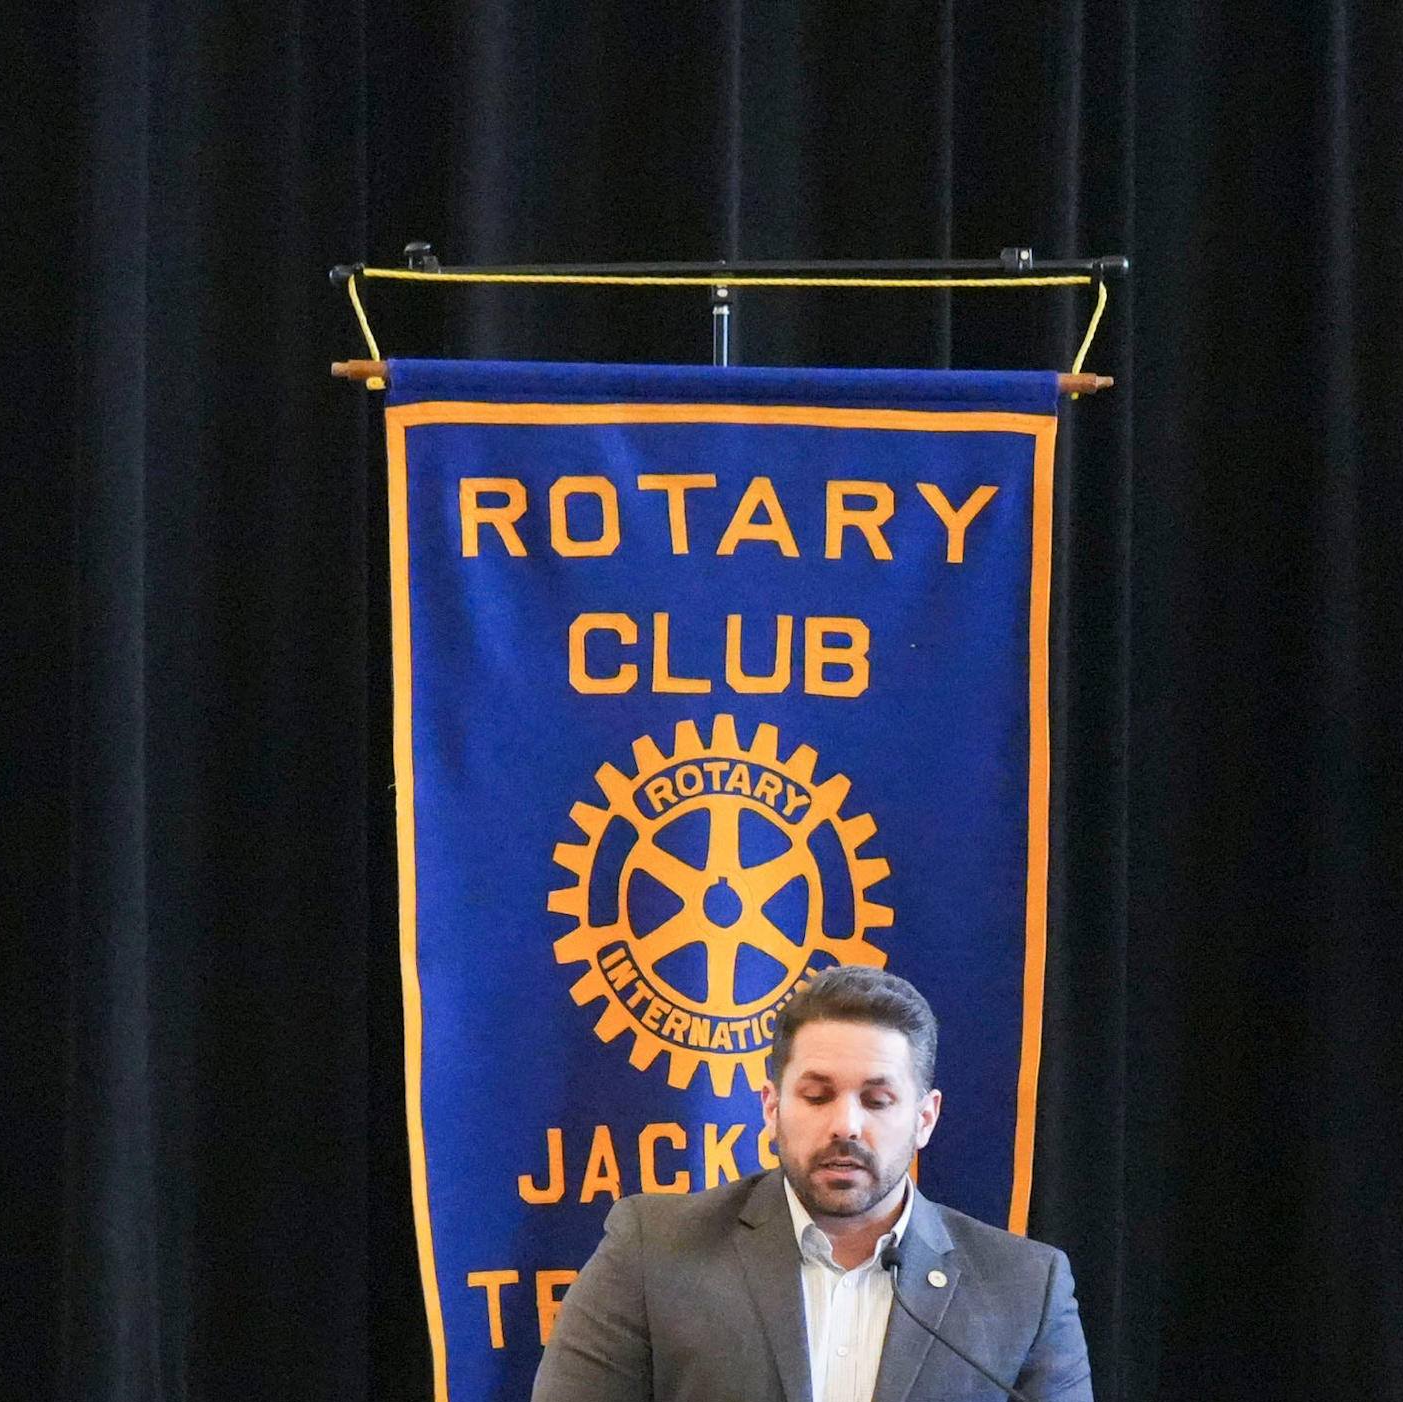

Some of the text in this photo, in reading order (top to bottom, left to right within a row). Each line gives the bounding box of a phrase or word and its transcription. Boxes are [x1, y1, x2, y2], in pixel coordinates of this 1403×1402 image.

[459, 474, 998, 563] ROTARY
[568, 612, 870, 698] CLUB
[644, 761, 811, 818] ROTARY
[601, 948, 835, 1051] INTERNATIO
